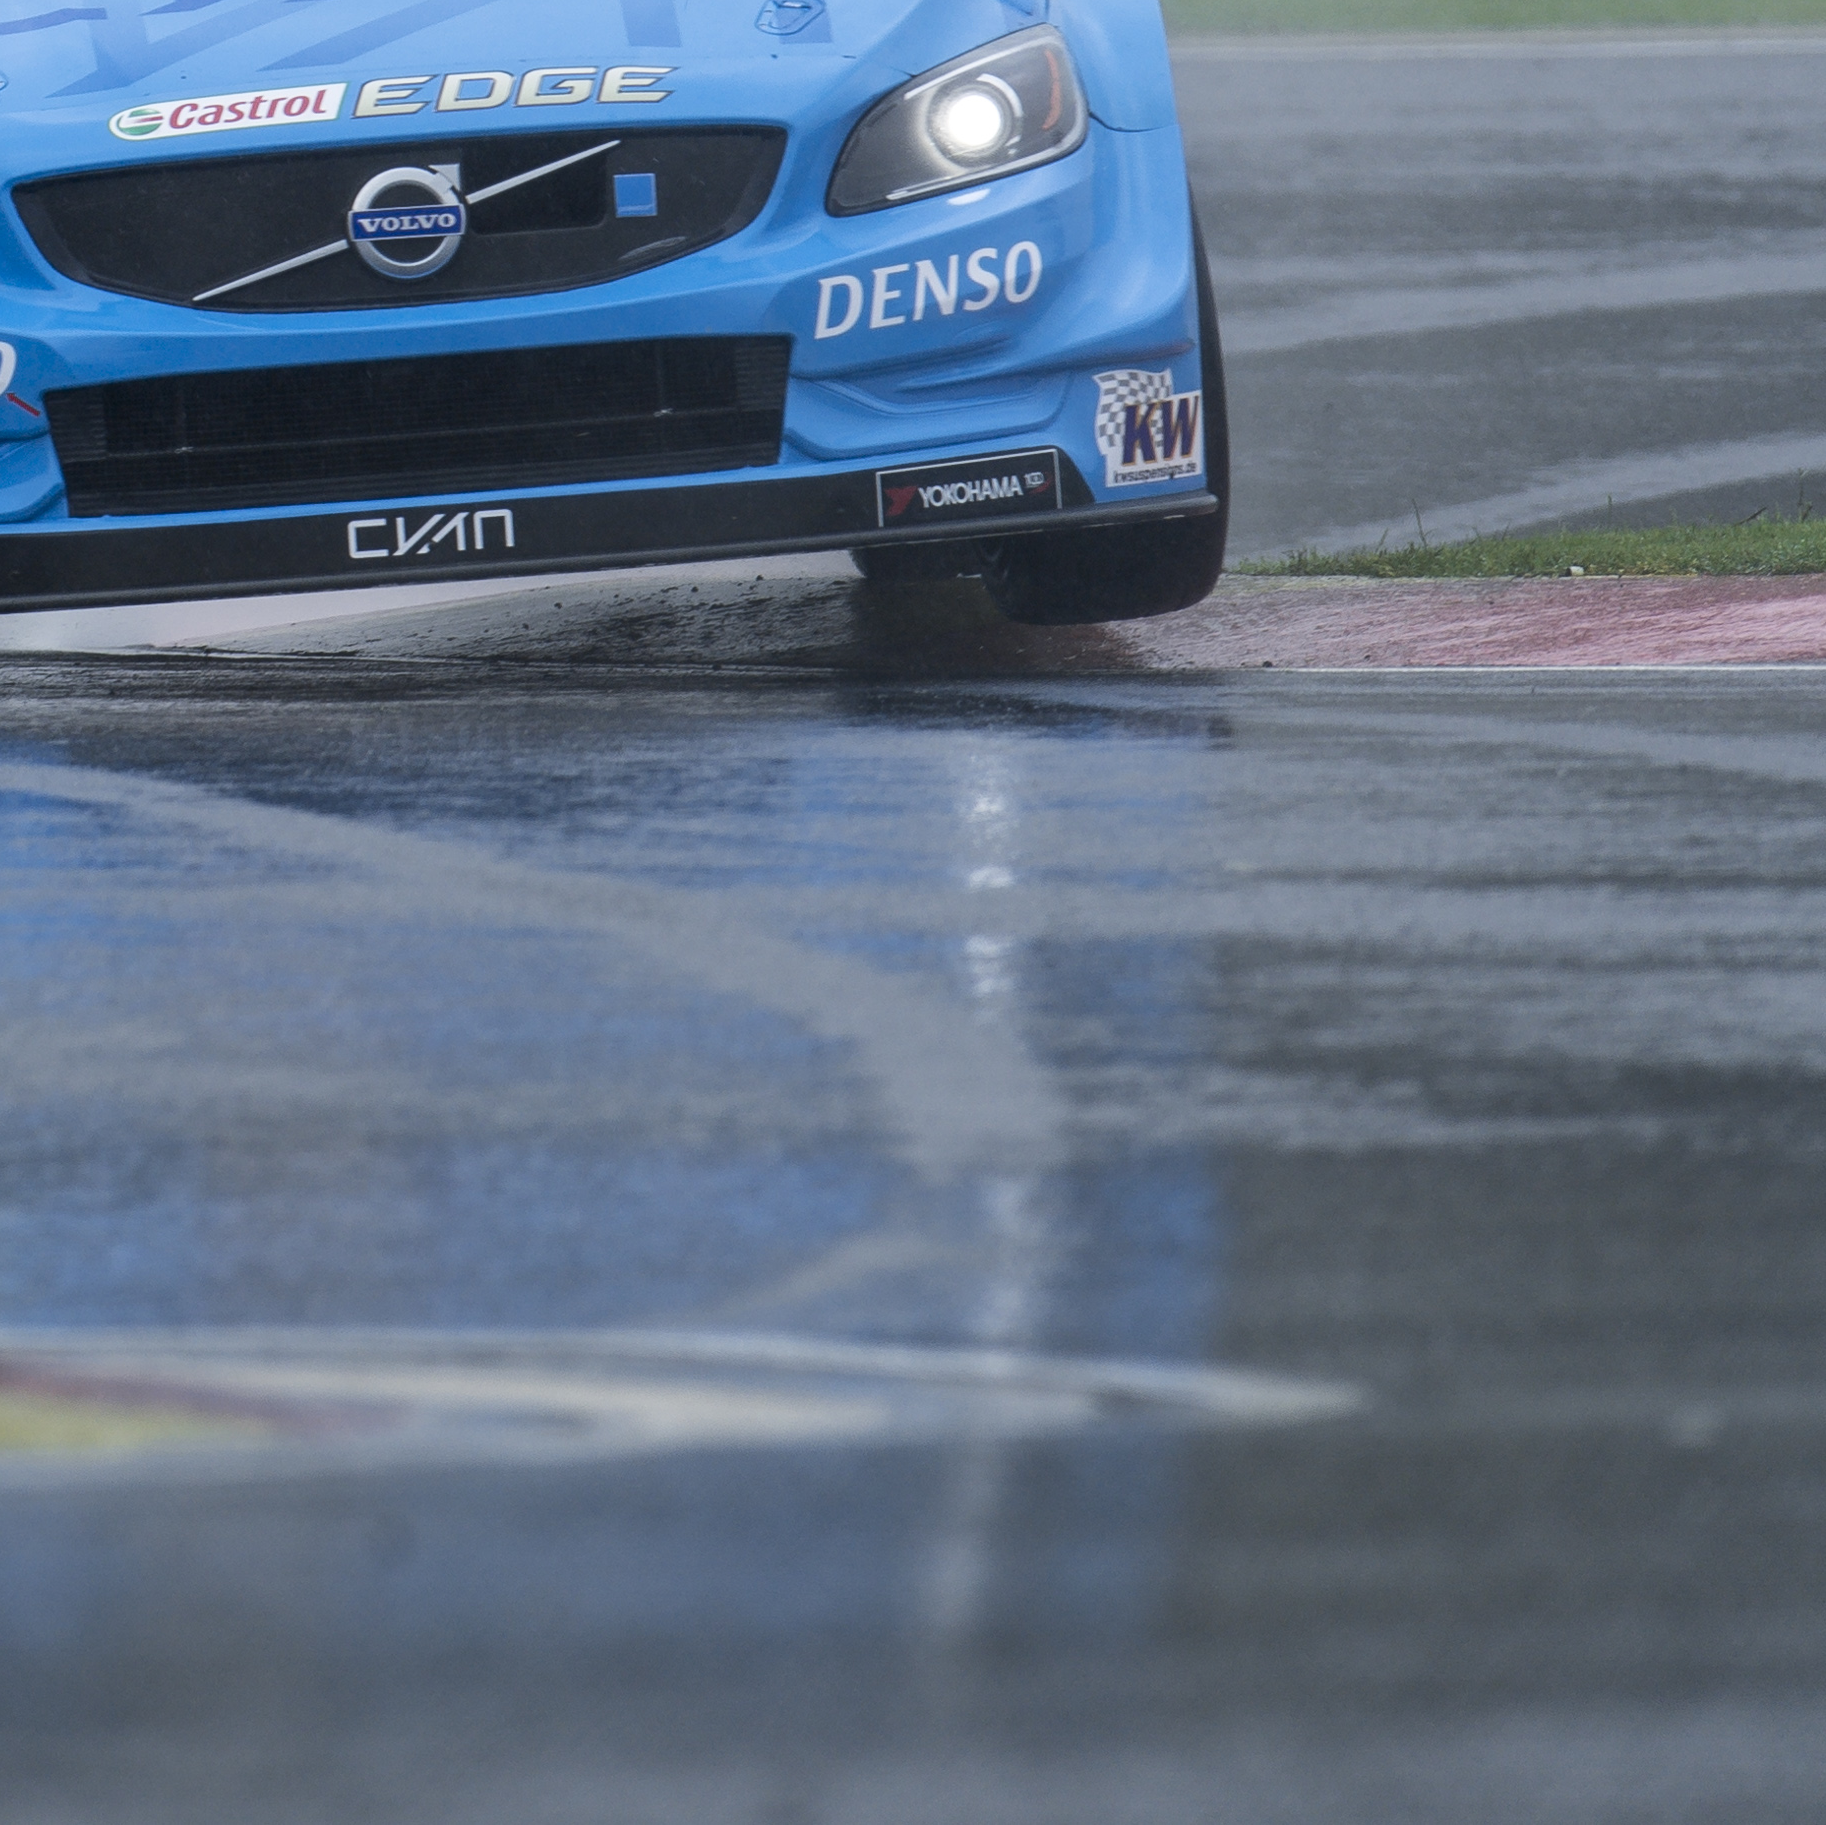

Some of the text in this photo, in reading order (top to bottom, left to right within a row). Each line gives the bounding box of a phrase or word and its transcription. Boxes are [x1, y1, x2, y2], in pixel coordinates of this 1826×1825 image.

[169, 65, 681, 130] Castrol EDGE
[356, 210, 457, 234] VOLVO
[814, 240, 1042, 341] DENSO
[1121, 394, 1200, 467] KW
[917, 474, 1024, 509] YOKOHAMA
